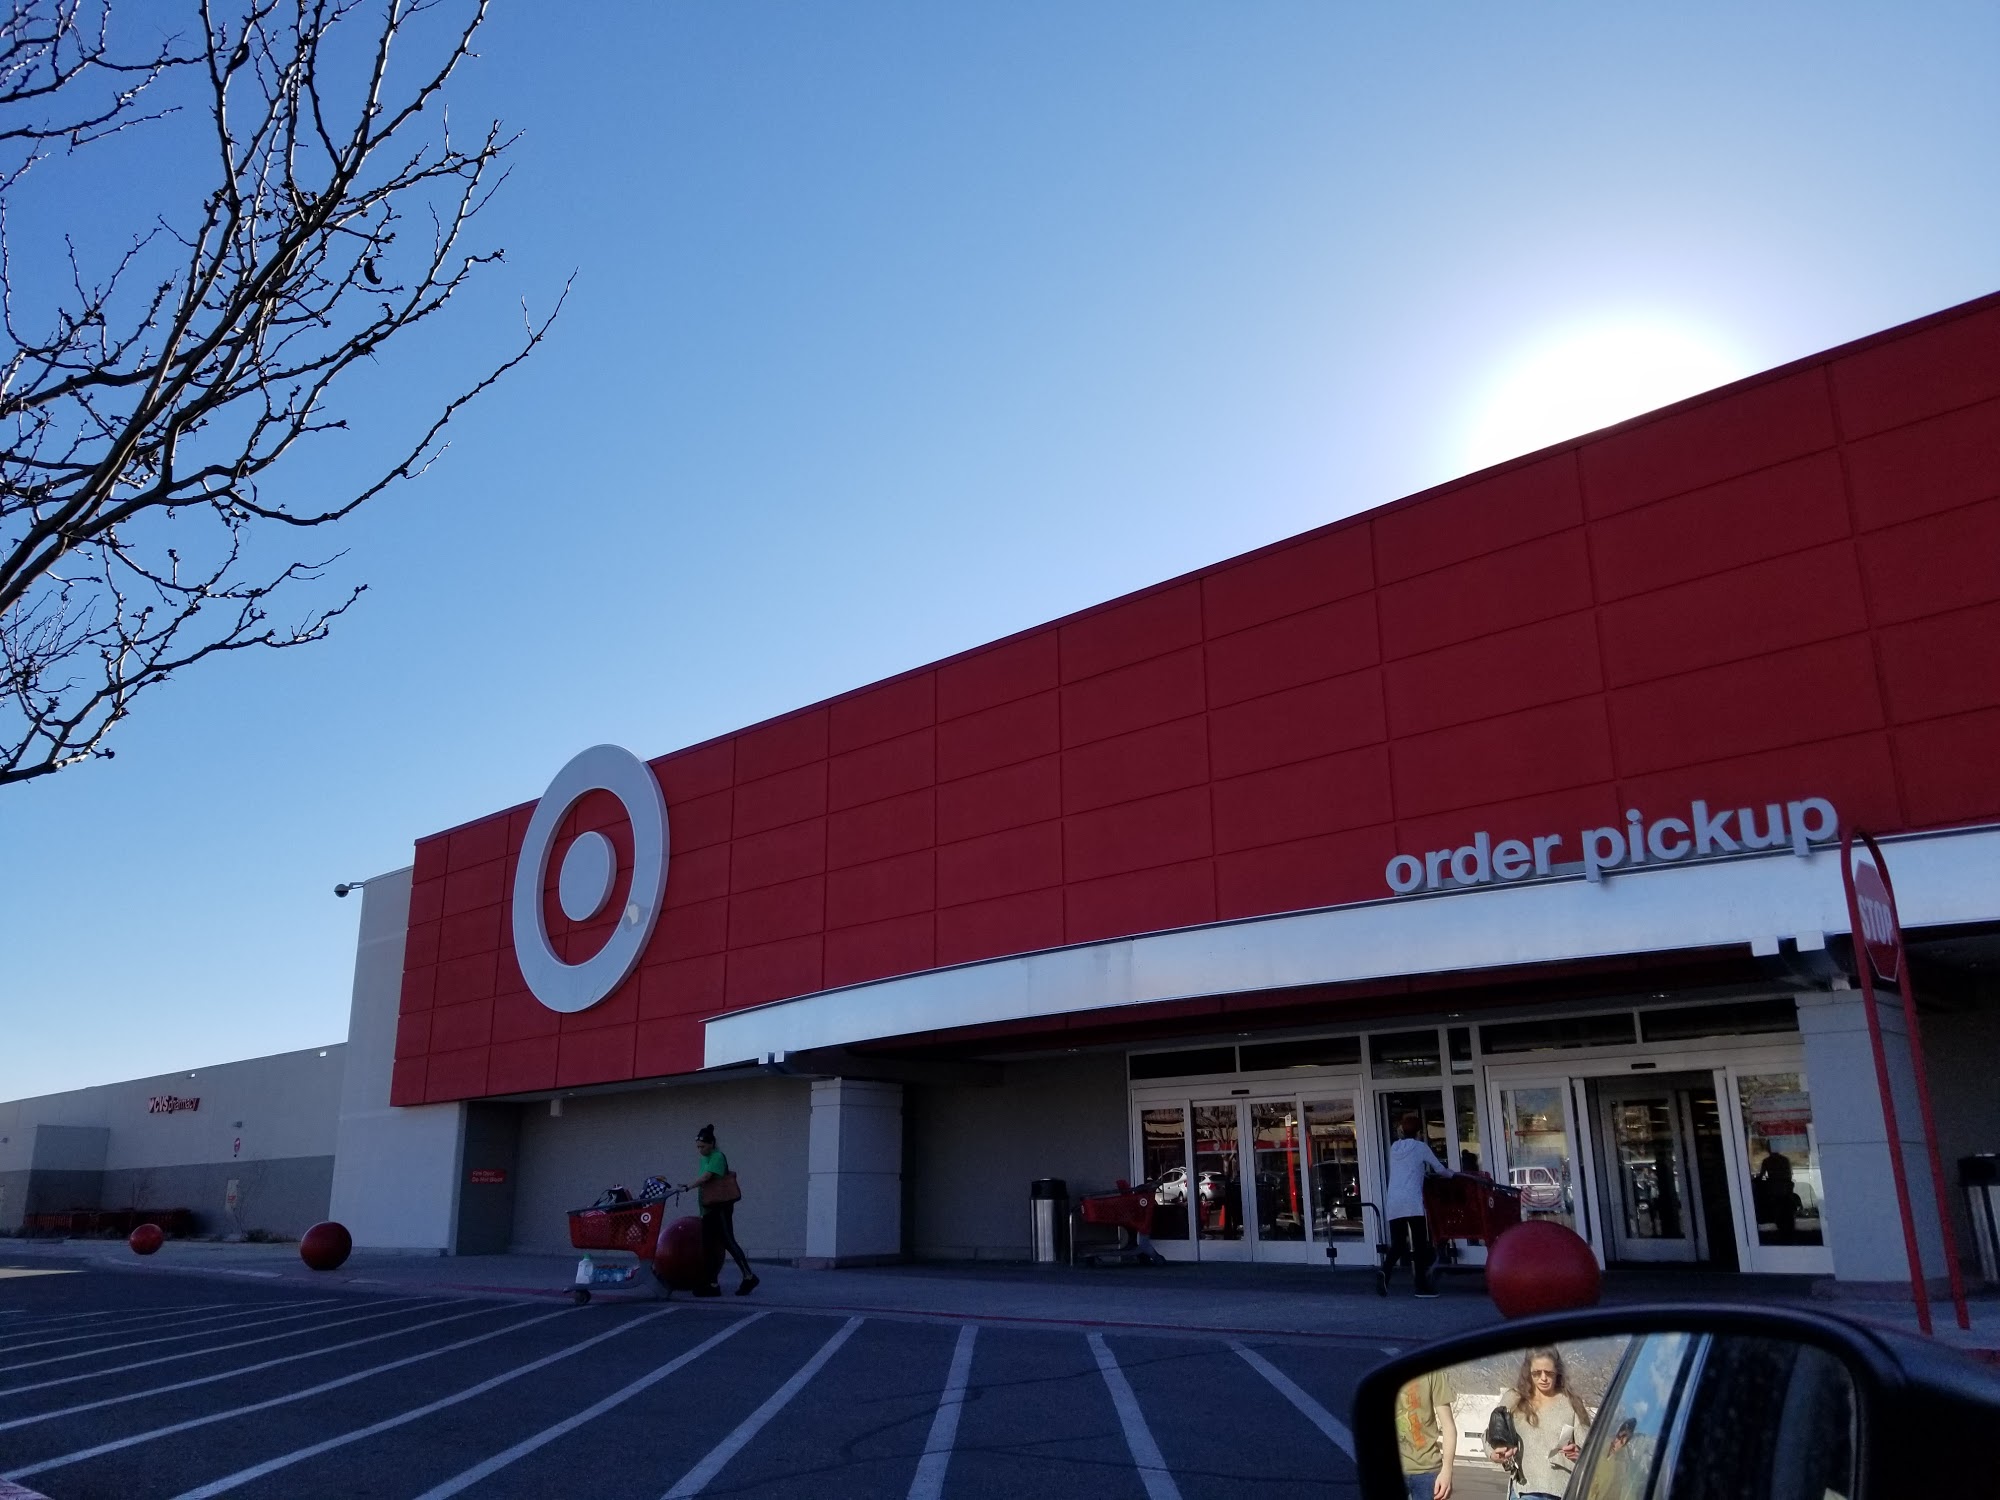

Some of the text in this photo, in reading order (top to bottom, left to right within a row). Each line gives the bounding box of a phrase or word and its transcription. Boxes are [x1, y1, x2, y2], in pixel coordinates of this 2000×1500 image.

[1385, 797, 1839, 893] order pickup
[1858, 895, 1894, 946] STOP
[154, 1096, 170, 1112] CVS
